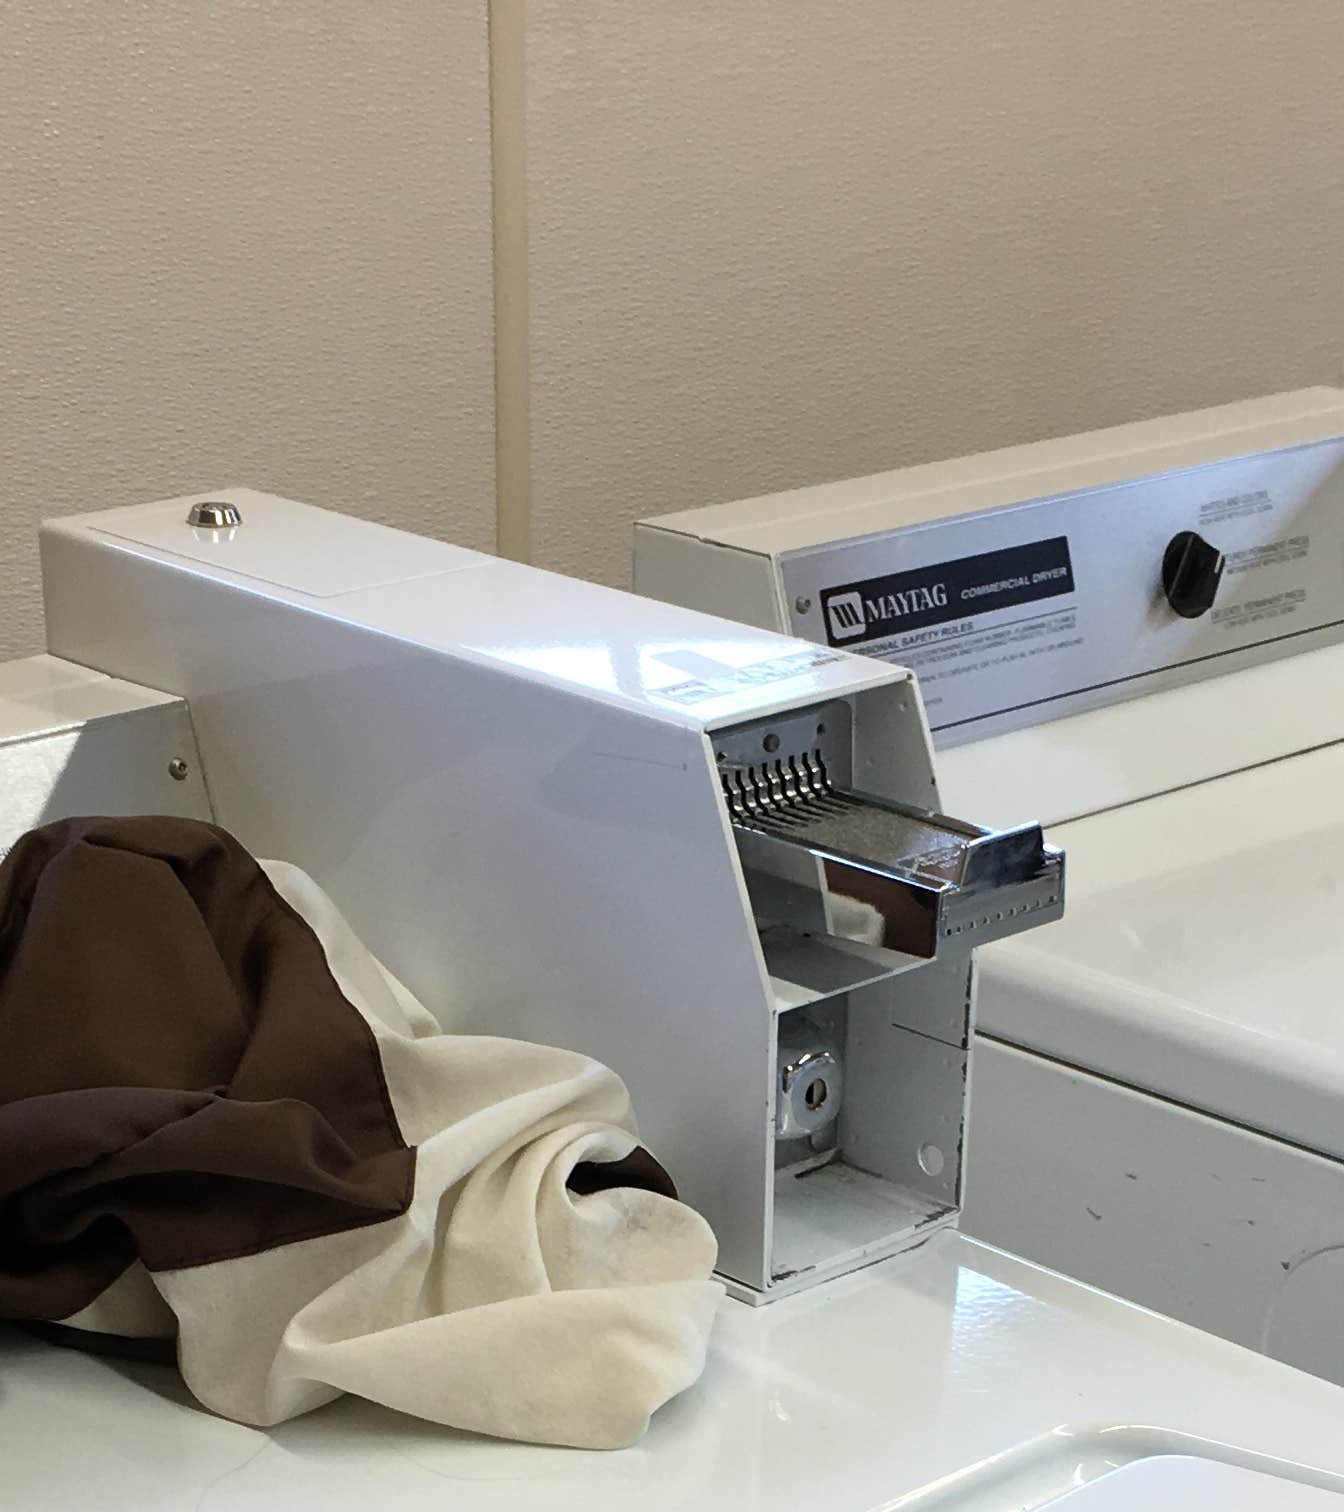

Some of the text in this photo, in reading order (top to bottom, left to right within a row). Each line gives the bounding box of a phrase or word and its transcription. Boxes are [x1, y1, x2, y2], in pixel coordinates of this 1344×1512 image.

[866, 567, 1068, 623] MAYTAG COMMERCIAL DRYER
[902, 630, 938, 646] SAFETY
[941, 621, 974, 636] RULES
